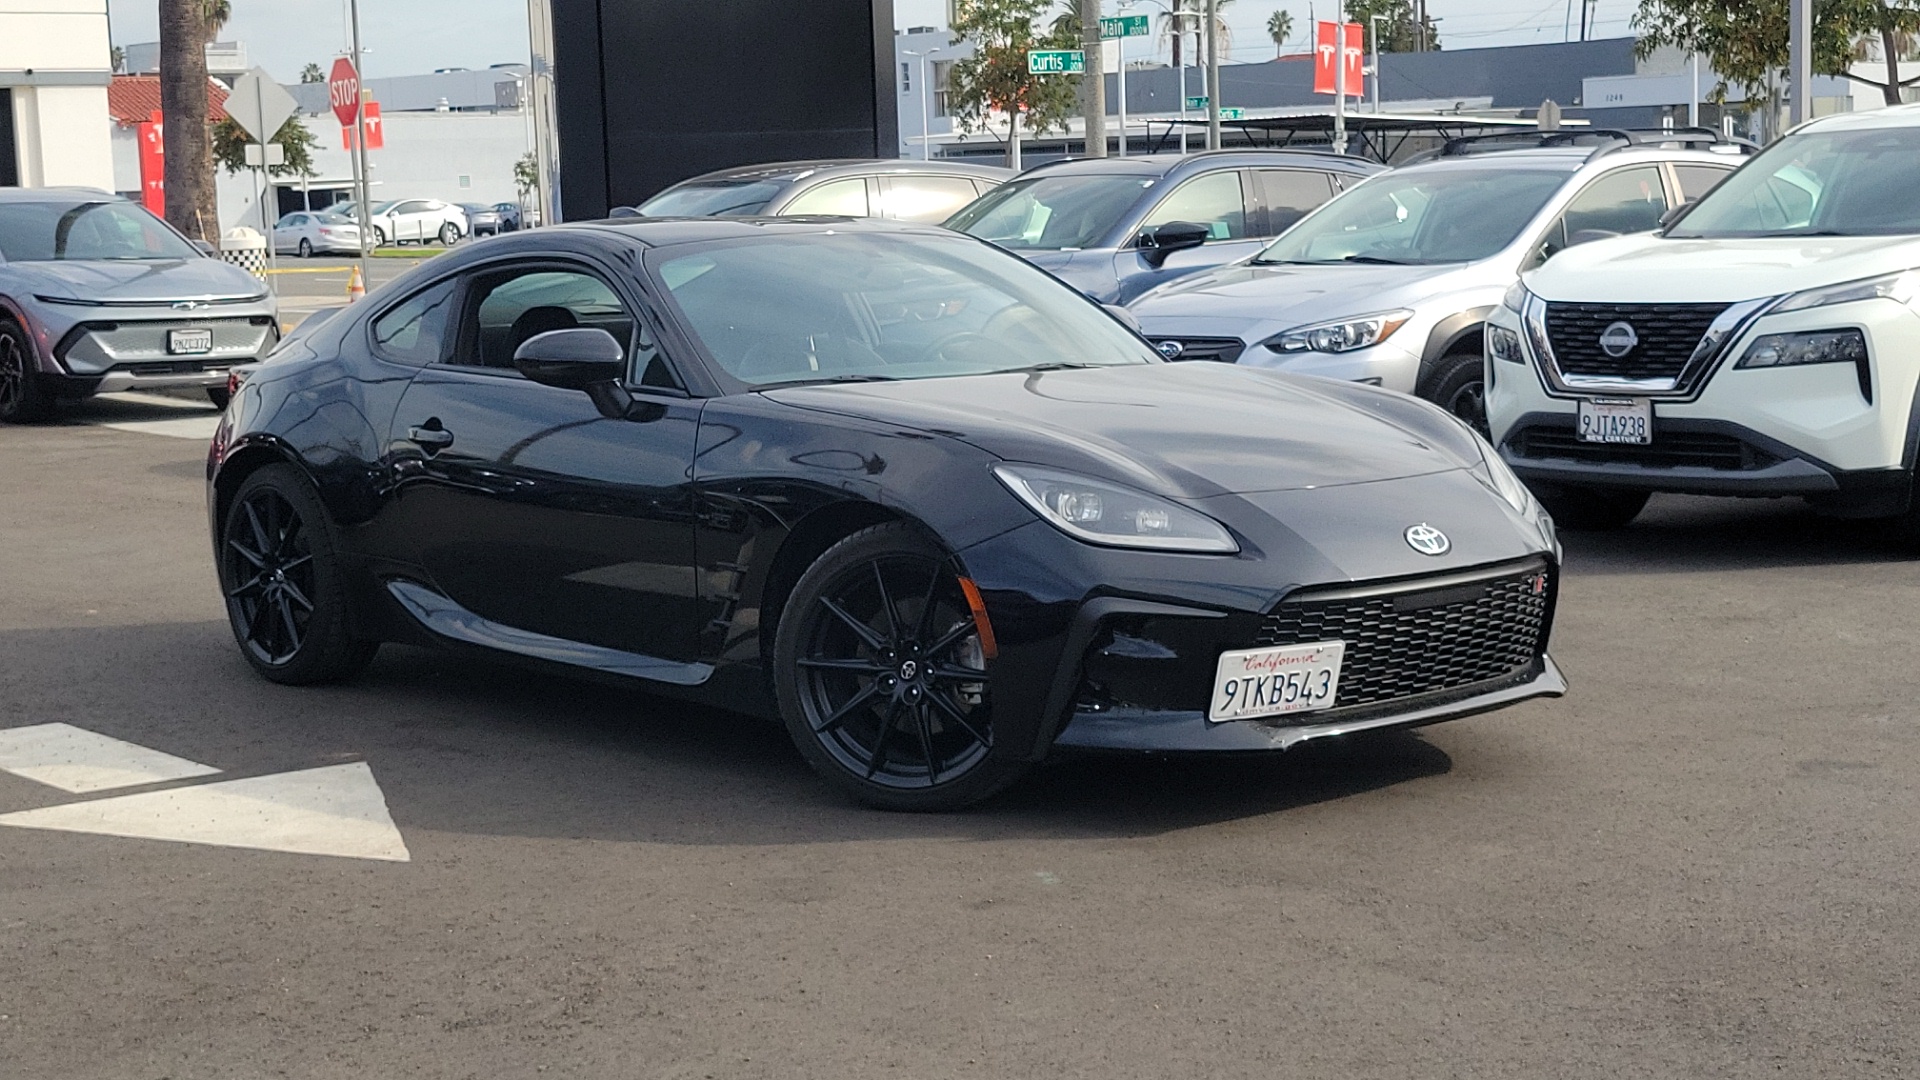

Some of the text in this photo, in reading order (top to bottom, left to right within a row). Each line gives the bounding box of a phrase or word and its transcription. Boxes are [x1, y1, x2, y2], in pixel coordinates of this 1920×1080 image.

[1100, 19, 1125, 38] Main
[1031, 54, 1064, 71] Curtis
[332, 78, 358, 107] STOP
[1582, 415, 1646, 436] 9JTA938
[1244, 653, 1320, 672] California
[1220, 668, 1333, 711] 9TKB543
